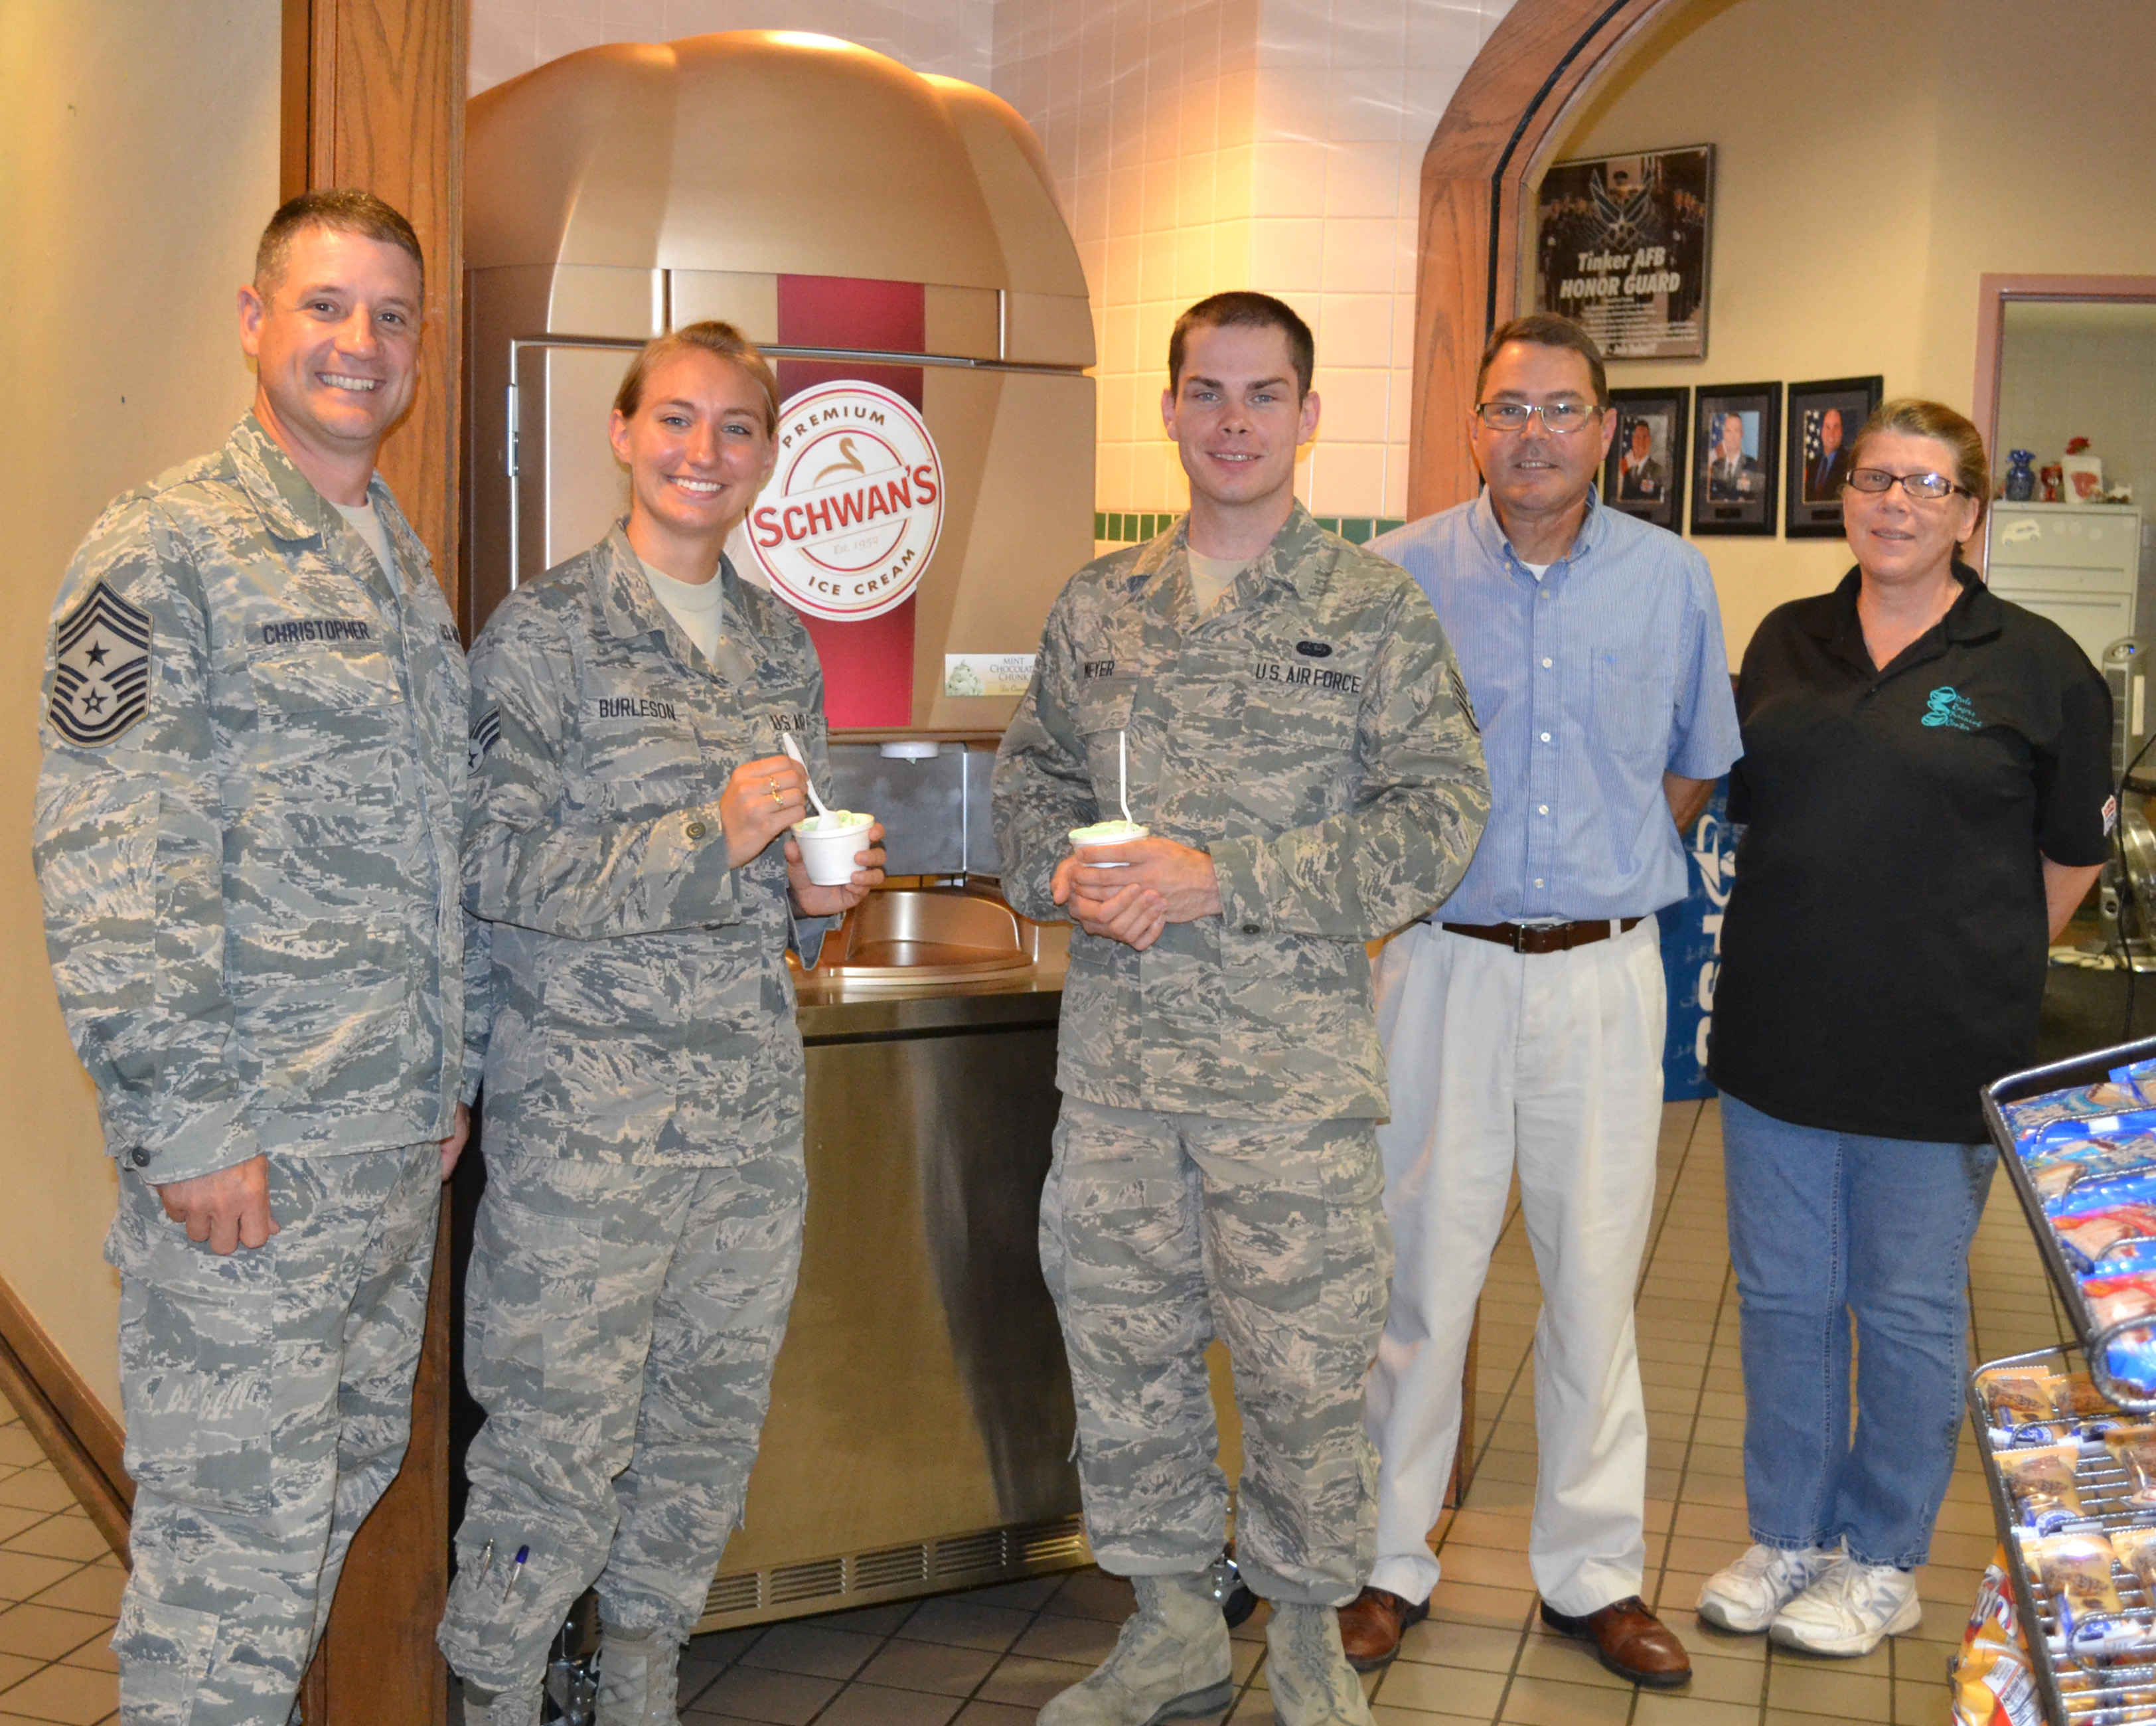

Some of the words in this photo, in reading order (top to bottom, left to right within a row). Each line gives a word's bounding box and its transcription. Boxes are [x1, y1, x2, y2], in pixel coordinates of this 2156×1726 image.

[1578, 248, 1632, 273] Tinker
[1633, 246, 1667, 268] AFB
[1560, 276, 1621, 299] HONOR
[1623, 272, 1681, 295] GUARD
[782, 406, 886, 449] PREMIUM
[753, 465, 938, 548] SCHWAN'S
[833, 543, 850, 555] Est.
[854, 536, 880, 550] 1952
[808, 576, 841, 595] ICE
[854, 548, 915, 595] CREAM
[263, 620, 371, 645] CHRISTOPHER
[990, 664, 1034, 673] CHOCOLAT
[1255, 663, 1282, 682] U.S.
[1285, 666, 1311, 686] AIR
[1313, 668, 1362, 694] FORCE
[599, 699, 676, 722] BURLESON
